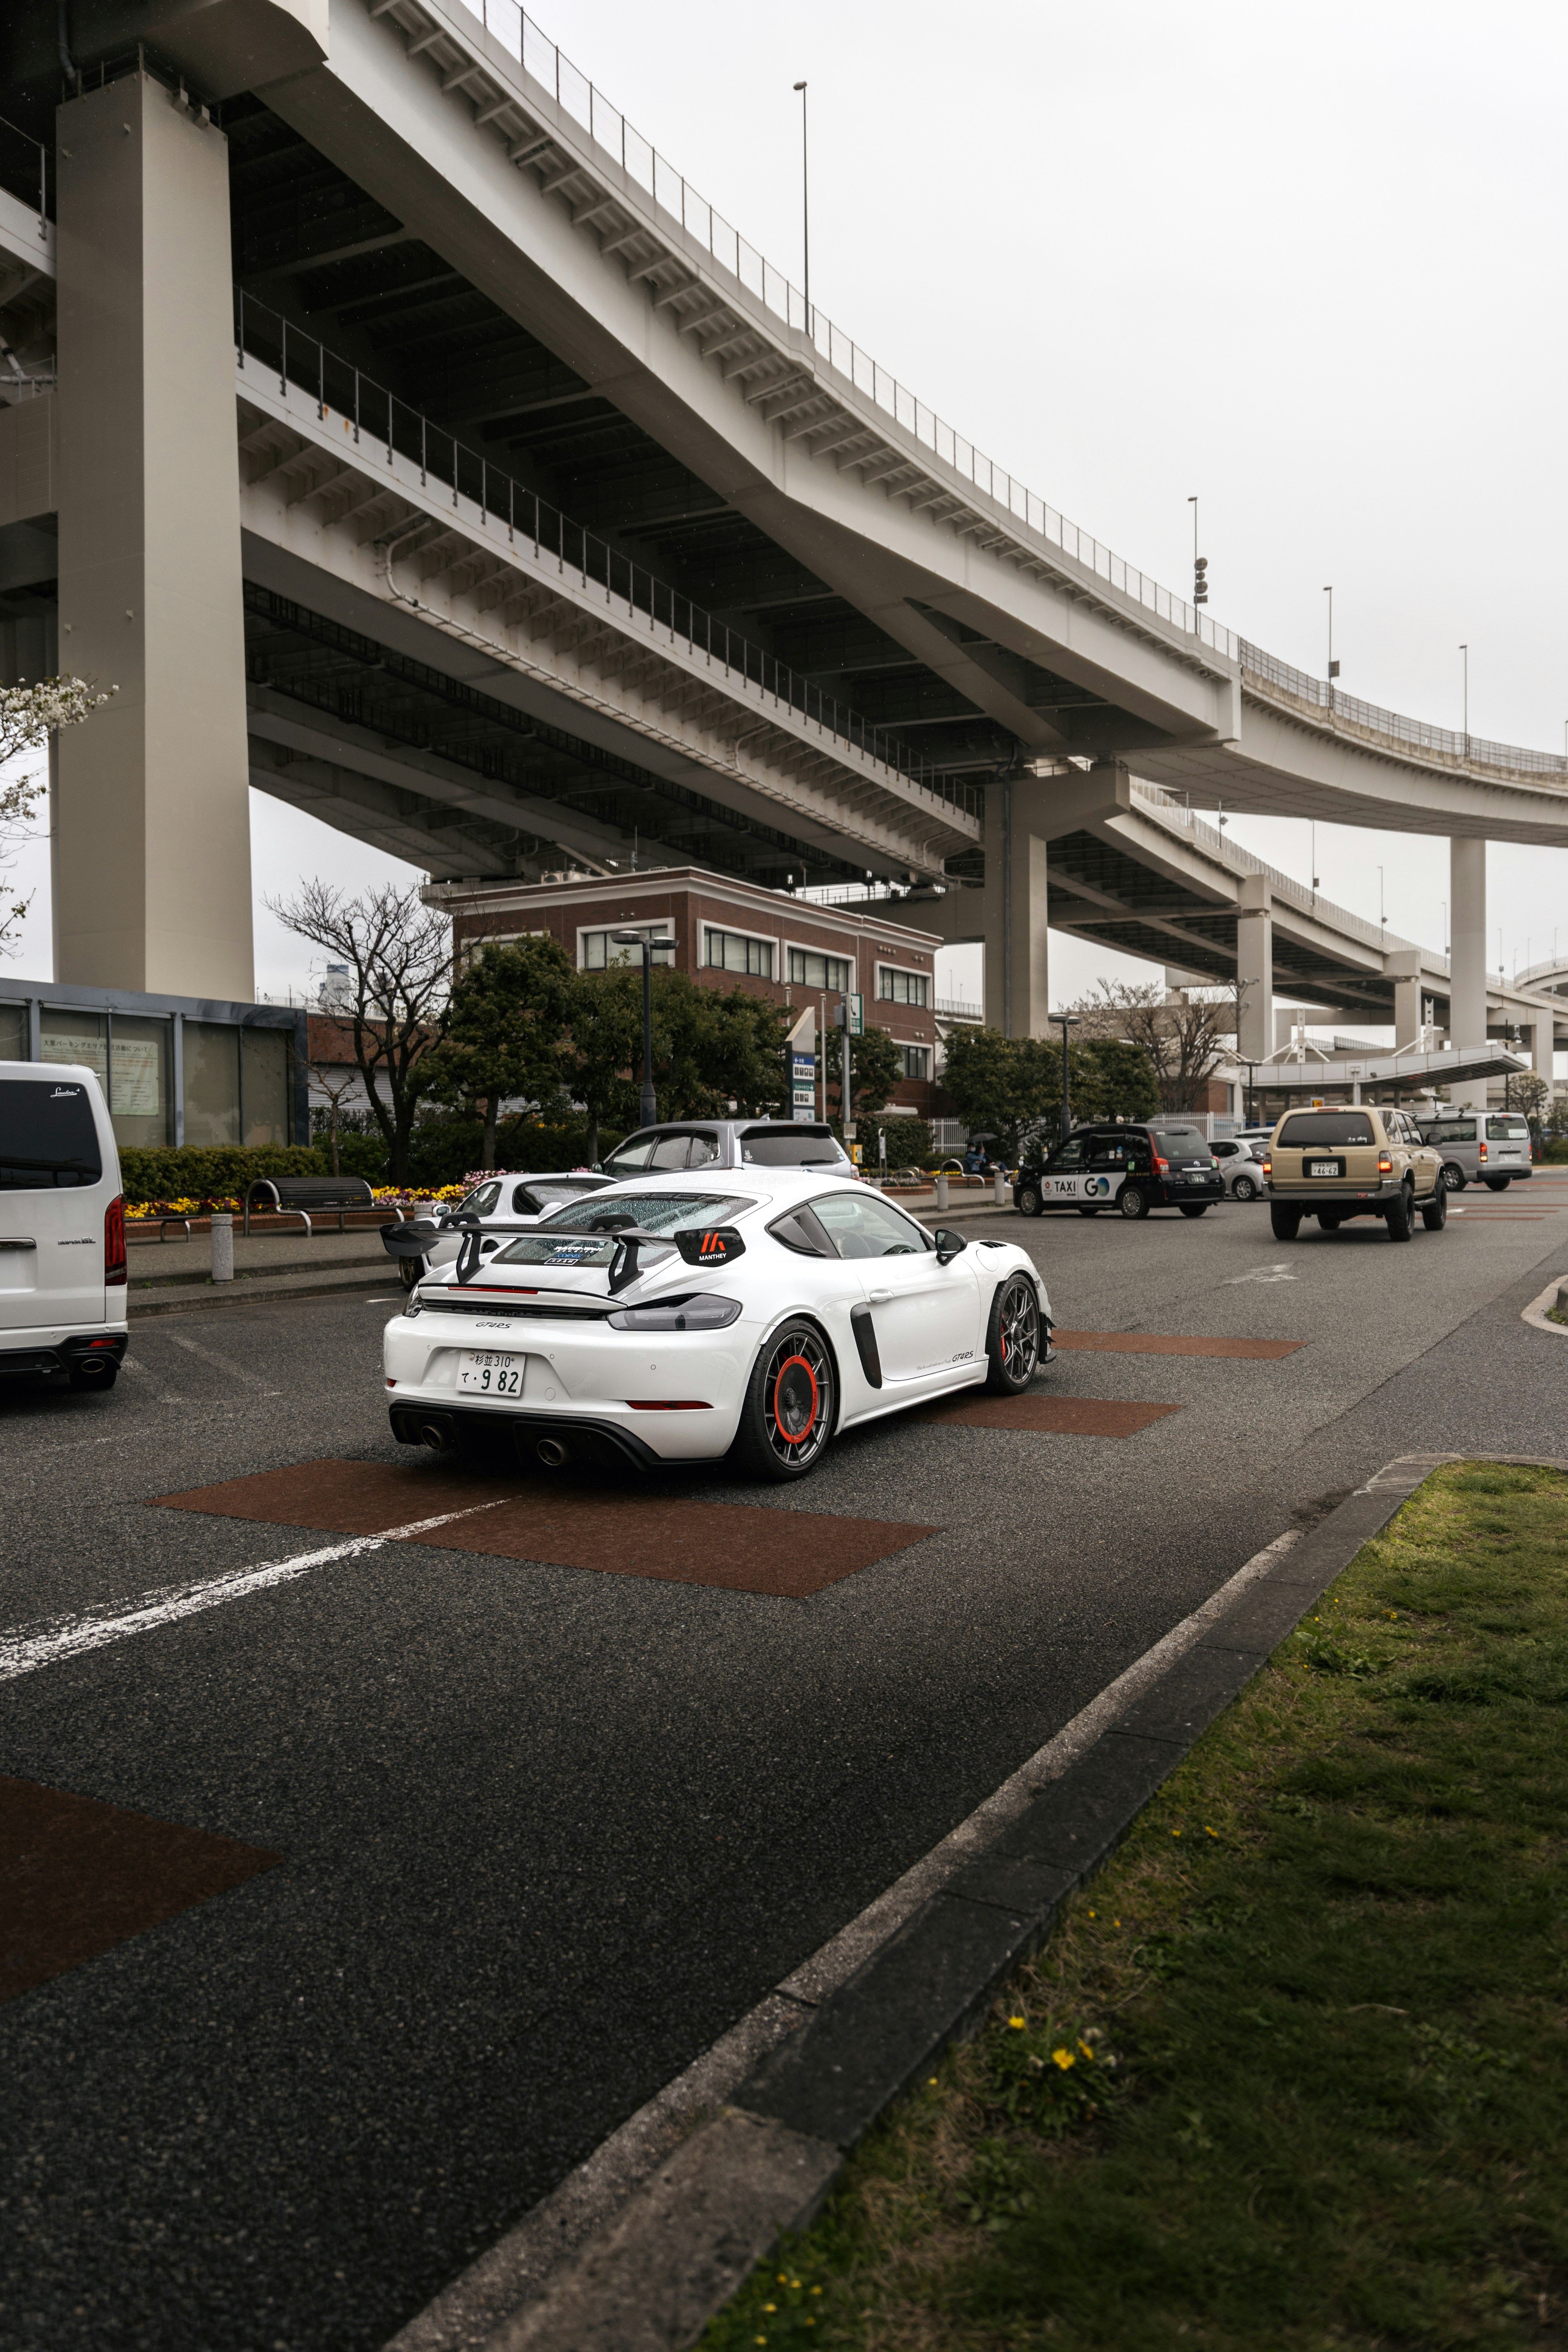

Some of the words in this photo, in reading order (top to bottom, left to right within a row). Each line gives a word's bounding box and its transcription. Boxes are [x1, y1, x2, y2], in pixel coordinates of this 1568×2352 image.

[1054, 1181, 1076, 1192] TAXI
[475, 1354, 493, 1366] 杉並
[494, 1356, 510, 1367] 310
[462, 1372, 469, 1383] て
